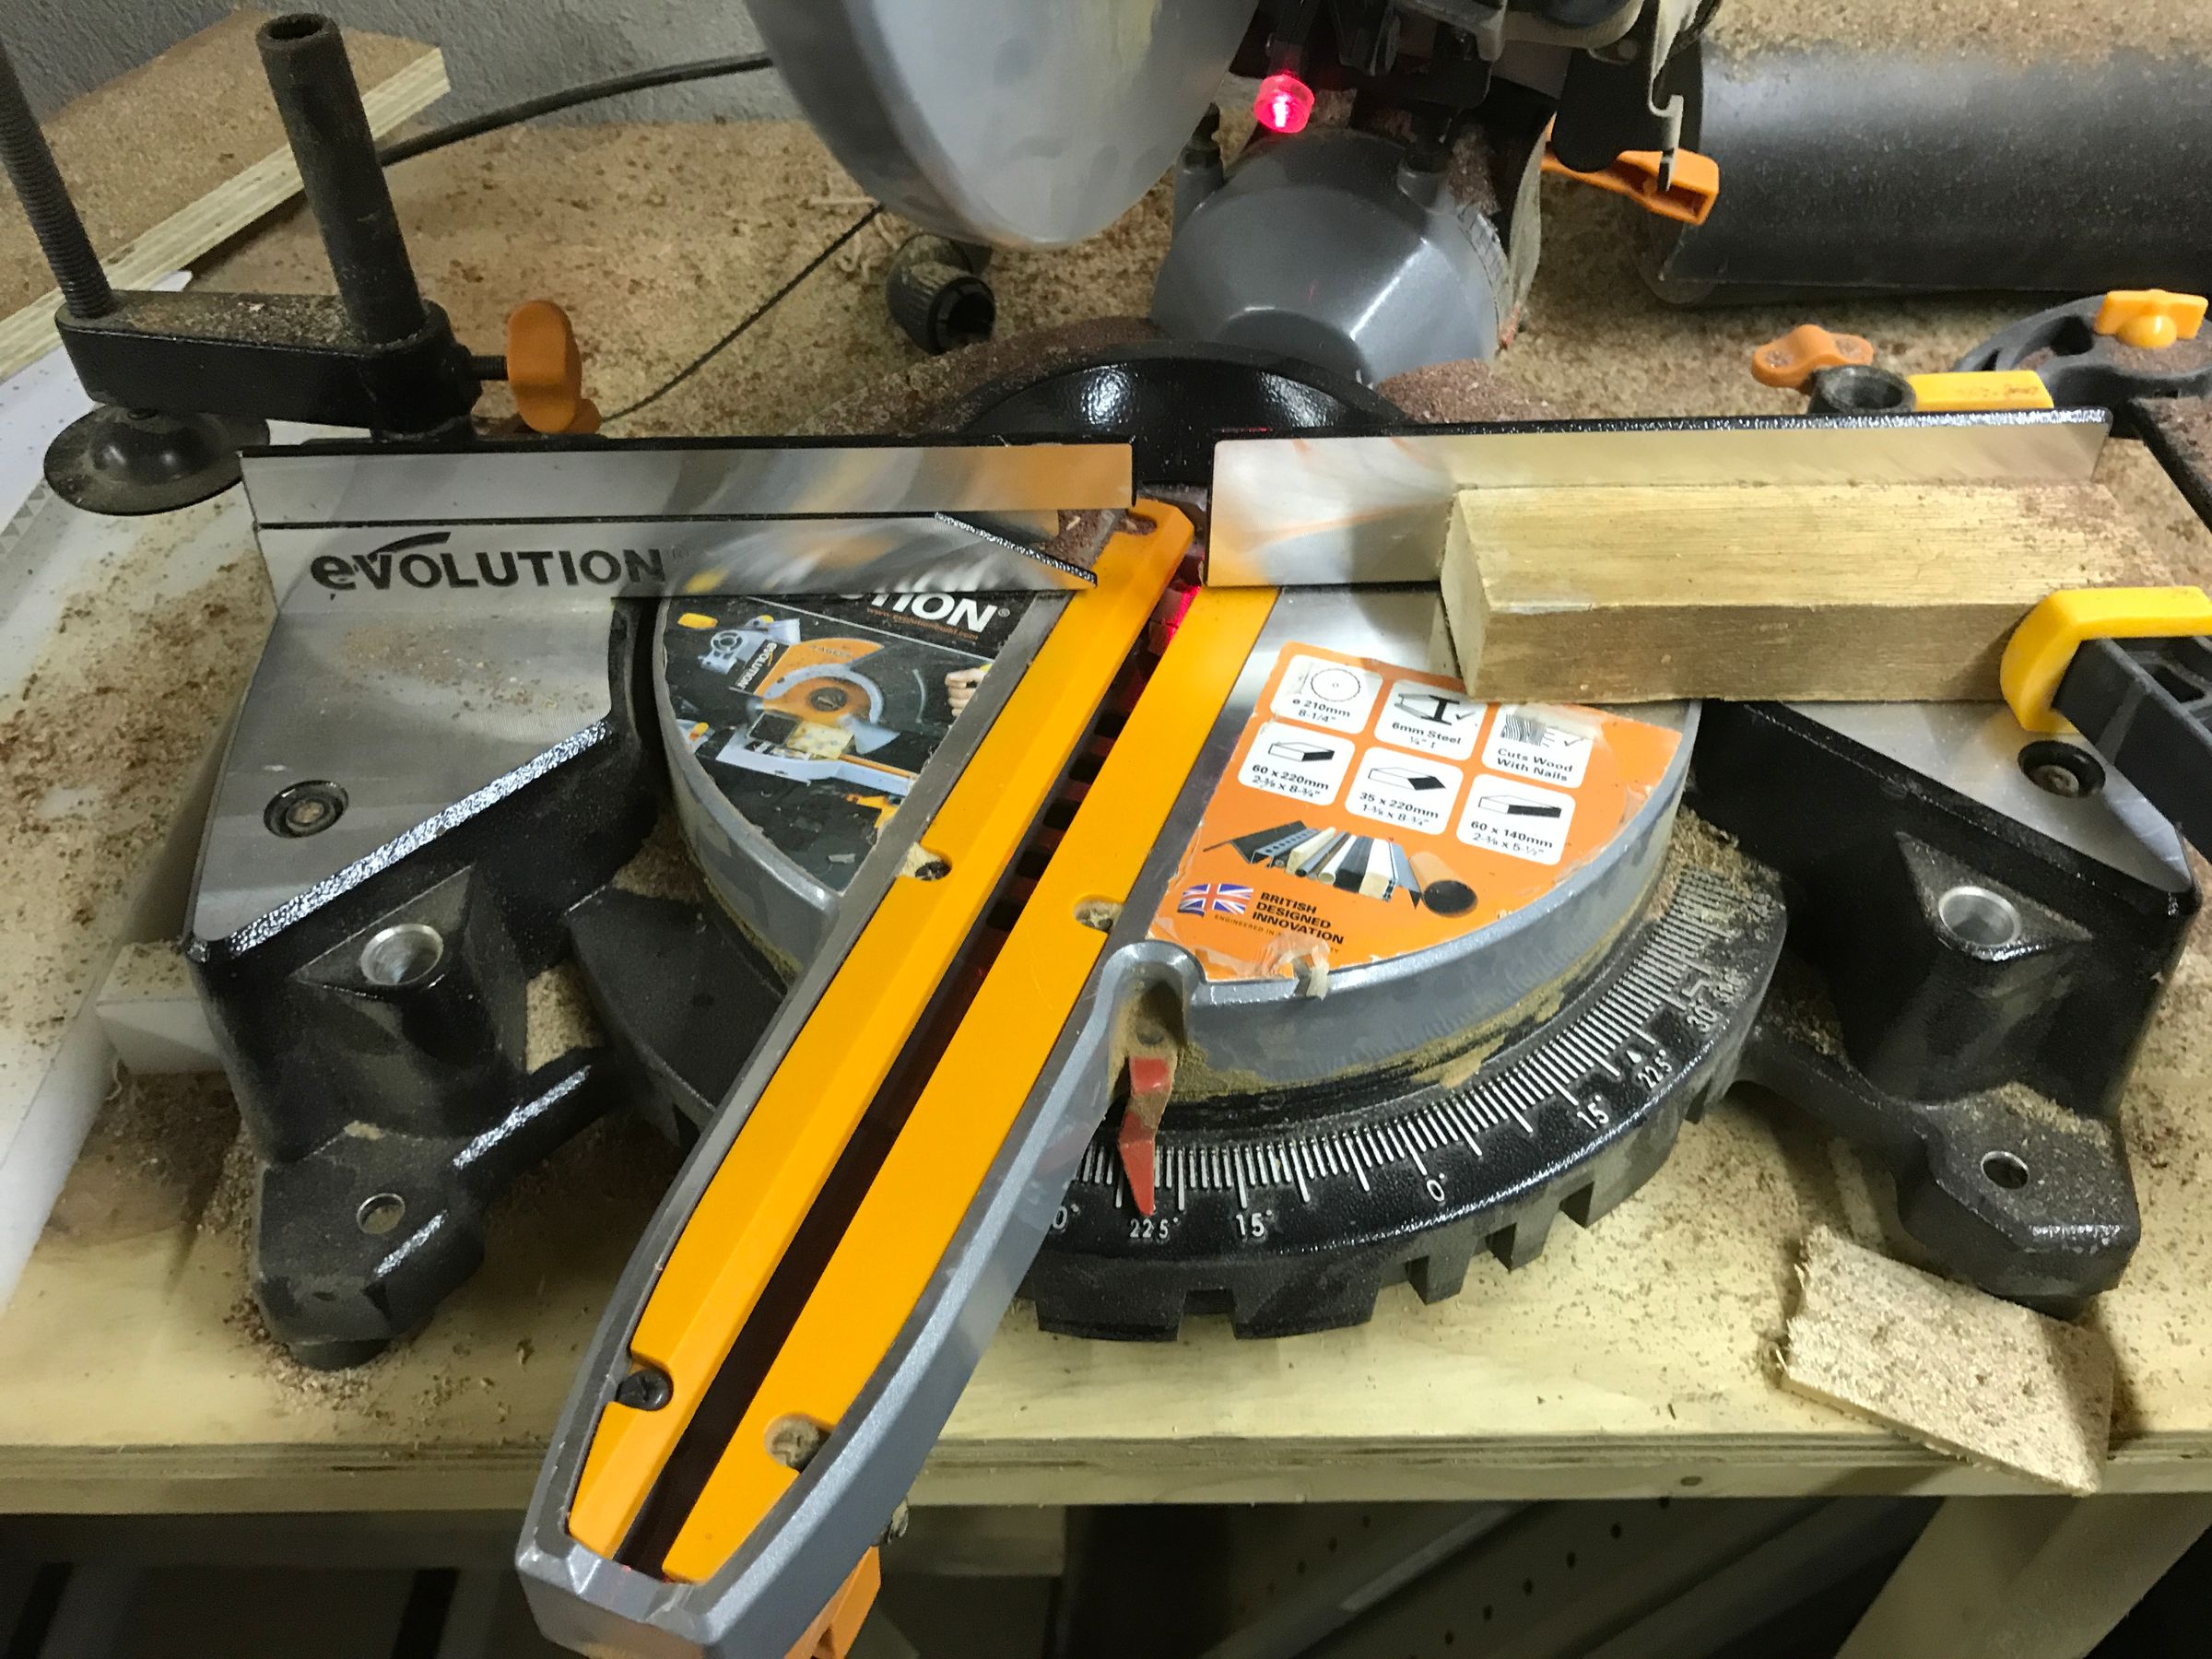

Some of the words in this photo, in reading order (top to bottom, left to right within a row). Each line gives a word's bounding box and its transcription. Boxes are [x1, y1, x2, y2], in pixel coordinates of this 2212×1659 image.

[1303, 700, 1350, 717] 210mm
[1392, 722, 1425, 735] 6mm
[1427, 730, 1462, 745] Steel
[1497, 757, 1529, 771] With
[1533, 767, 1568, 782] Nails
[1498, 747, 1529, 762] Cuts
[1533, 756, 1573, 772] Wood
[1252, 764, 1269, 774] 60
[1271, 770, 1279, 778] x
[1280, 771, 1329, 791] 220mm
[1277, 782, 1287, 791] x
[1359, 792, 1376, 803] 35
[1379, 797, 1387, 806] x
[1388, 799, 1440, 818] 220mm
[1386, 811, 1394, 819] x
[1470, 820, 1488, 831] 60
[1503, 829, 1553, 849] 140mm
[1500, 841, 1509, 849] x
[1255, 901, 1332, 929] DESIGNED
[1260, 891, 1317, 915] BRITISH
[1252, 911, 1345, 945] INNOVATION
